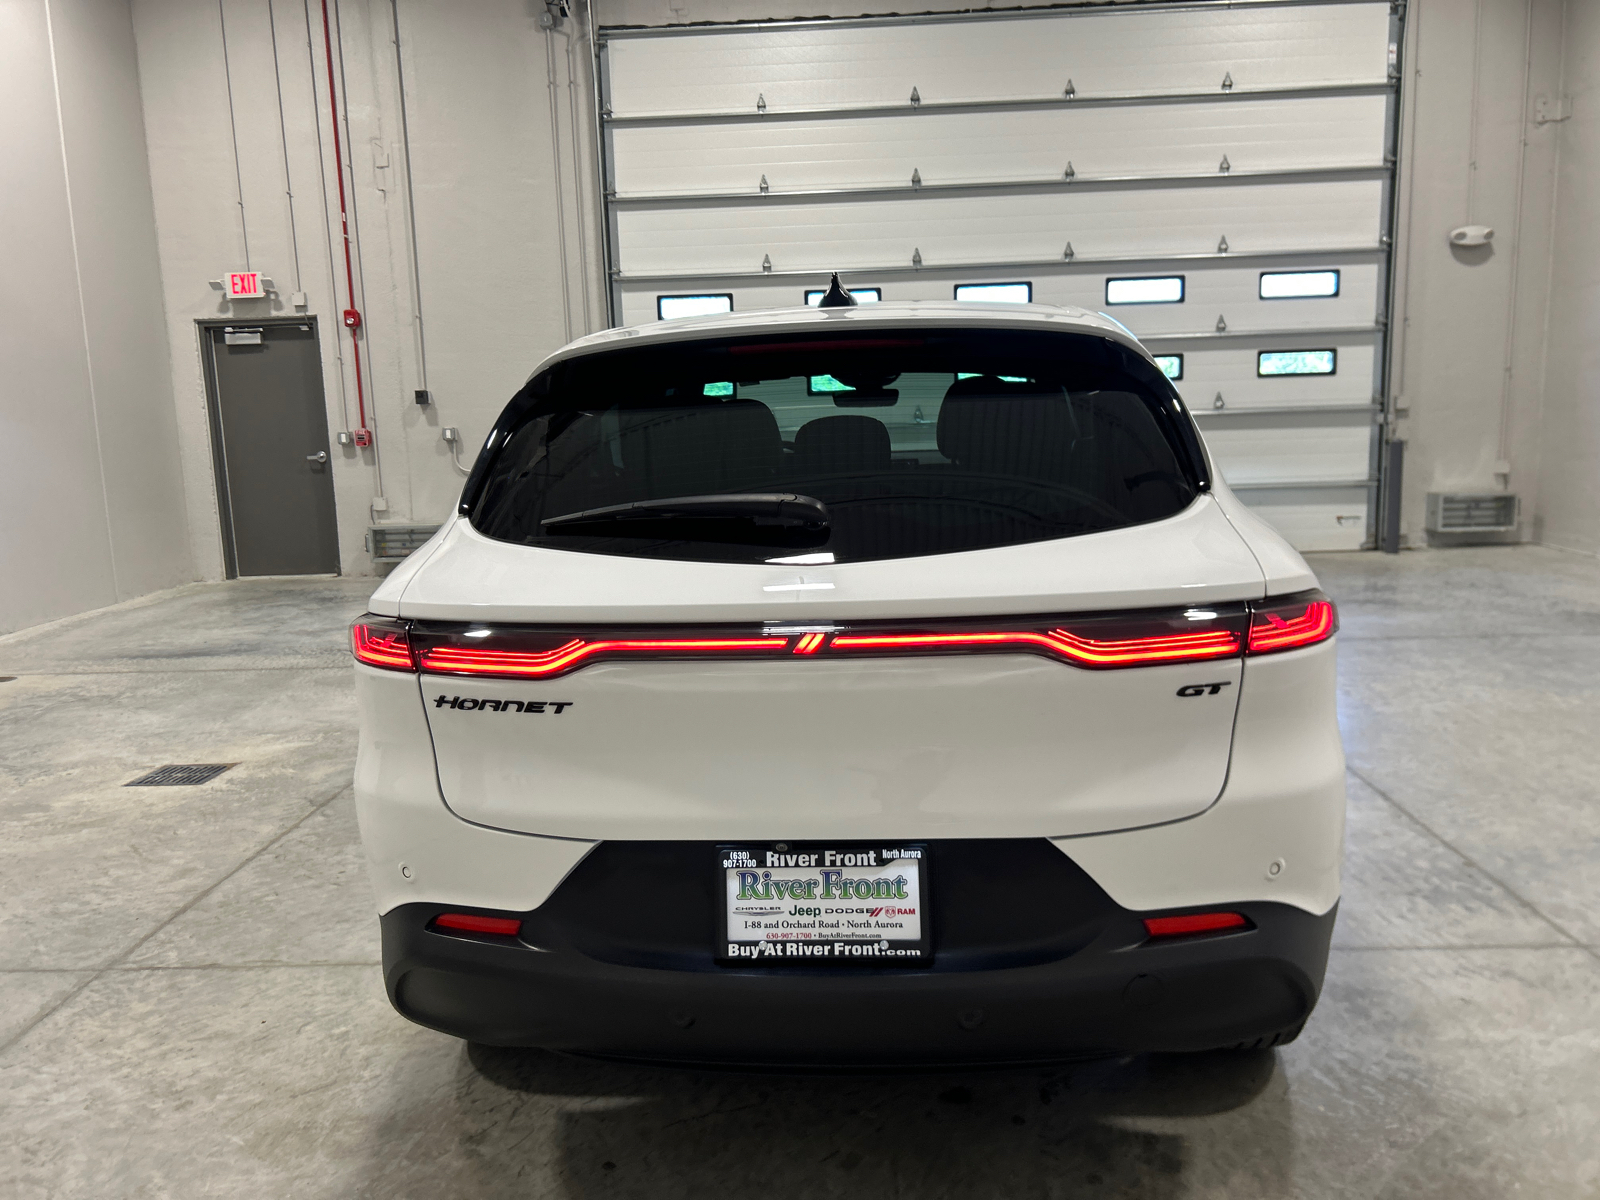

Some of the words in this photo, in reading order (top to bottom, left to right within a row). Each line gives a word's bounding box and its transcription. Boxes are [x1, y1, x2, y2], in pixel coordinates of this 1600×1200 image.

[231, 273, 257, 294] EXIT
[1176, 681, 1232, 697] GT
[433, 695, 574, 714] HORNET
[729, 851, 750, 860] (630)
[766, 851, 818, 867] River
[824, 850, 877, 866] Front
[882, 849, 900, 859] North
[900, 849, 921, 859] Aurora
[723, 859, 757, 868] 907-1700
[788, 904, 822, 918] Jeep
[744, 920, 762, 929] I-88
[763, 920, 780, 929] and
[781, 920, 816, 929] Orchard
[818, 920, 840, 929] Road
[846, 920, 872, 928] North
[873, 920, 904, 928] Aurora
[818, 932, 882, 940] BuyAtRiverFront.com
[728, 943, 760, 959] Buy
[764, 942, 784, 956] At
[786, 942, 831, 956] River
